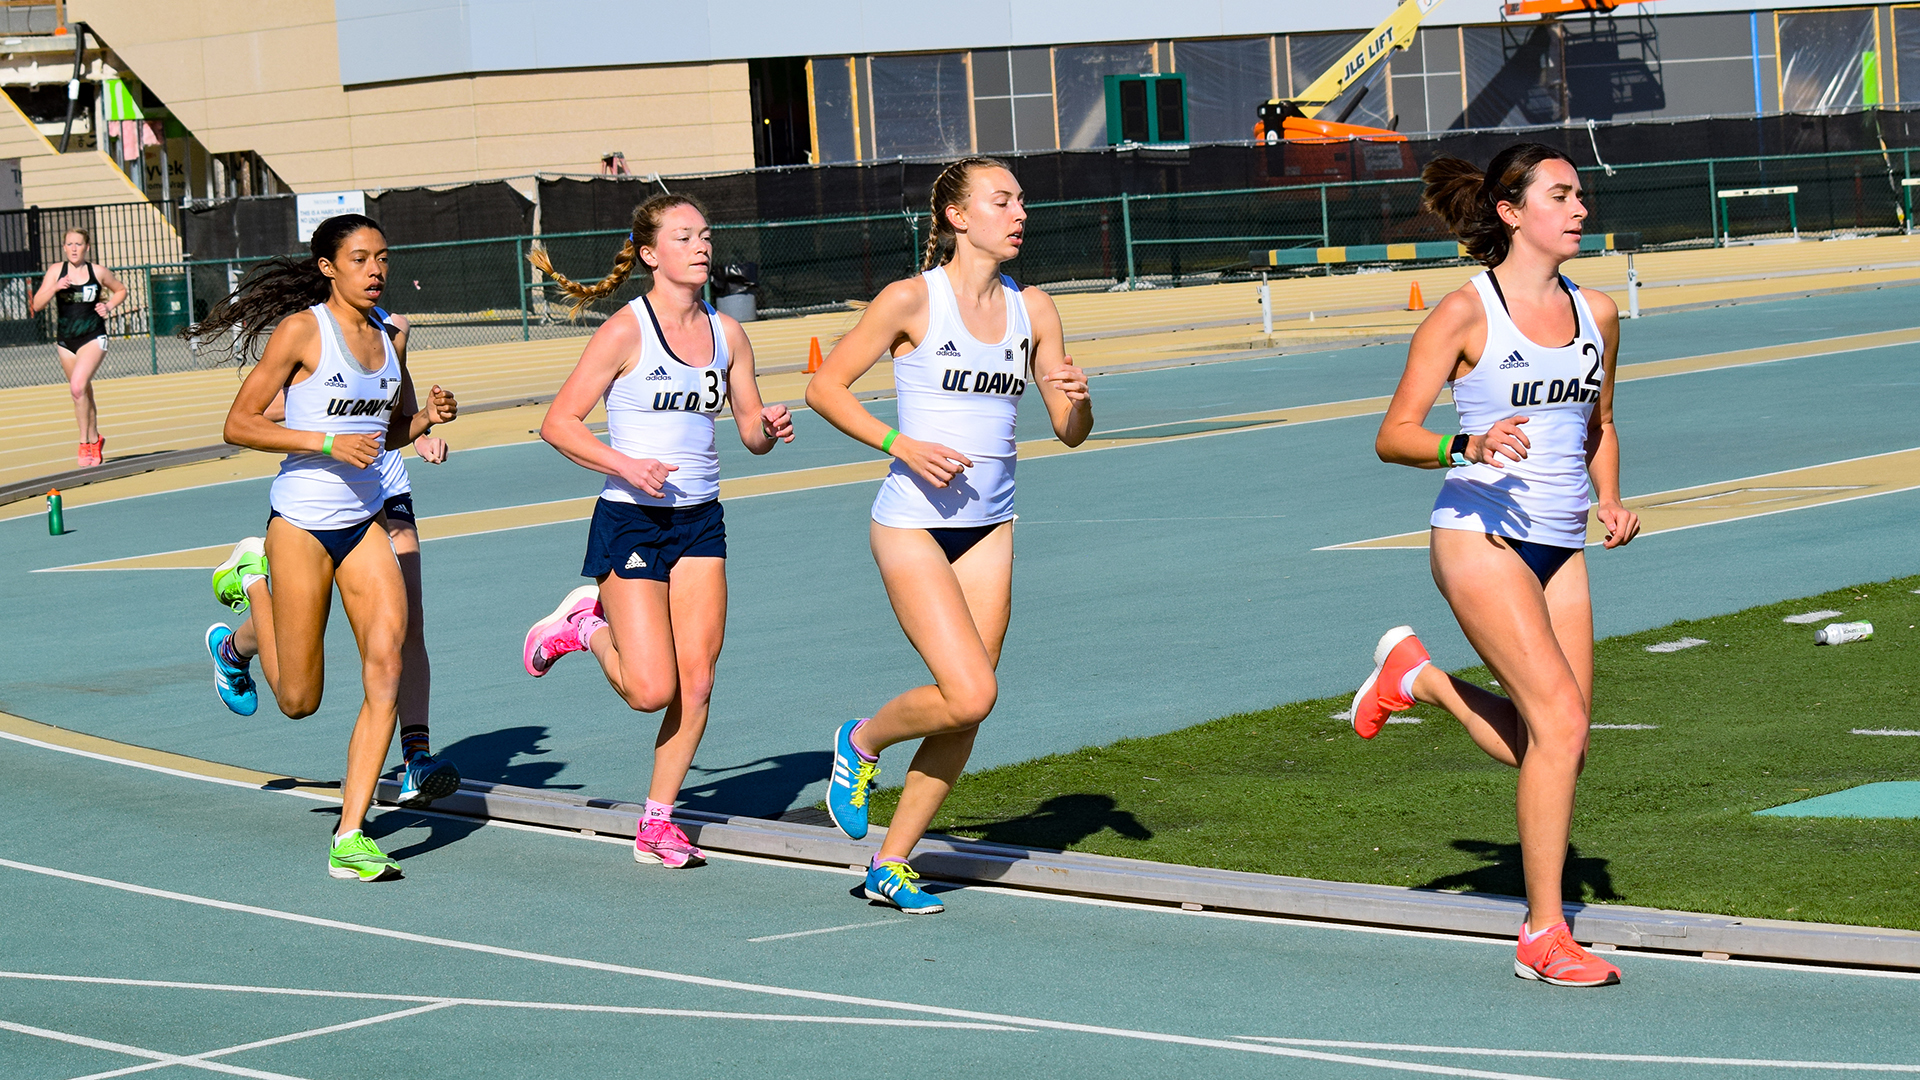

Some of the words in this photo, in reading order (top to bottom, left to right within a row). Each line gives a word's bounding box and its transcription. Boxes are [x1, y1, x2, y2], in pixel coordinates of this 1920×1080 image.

[1344, 52, 1365, 81] JLG
[1368, 26, 1393, 59] LIFT
[146, 160, 184, 180] yvek
[87, 287, 93, 301] 7
[1020, 337, 1029, 379] 1
[1499, 361, 1530, 370] adidas
[1582, 343, 1601, 387] 2
[324, 381, 348, 389] adidas
[705, 370, 719, 409] 3
[942, 368, 972, 392] UC
[653, 391, 683, 411] UC
[1511, 380, 1544, 407] UC
[326, 398, 354, 416] UC
[349, 398, 388, 417] DAV
